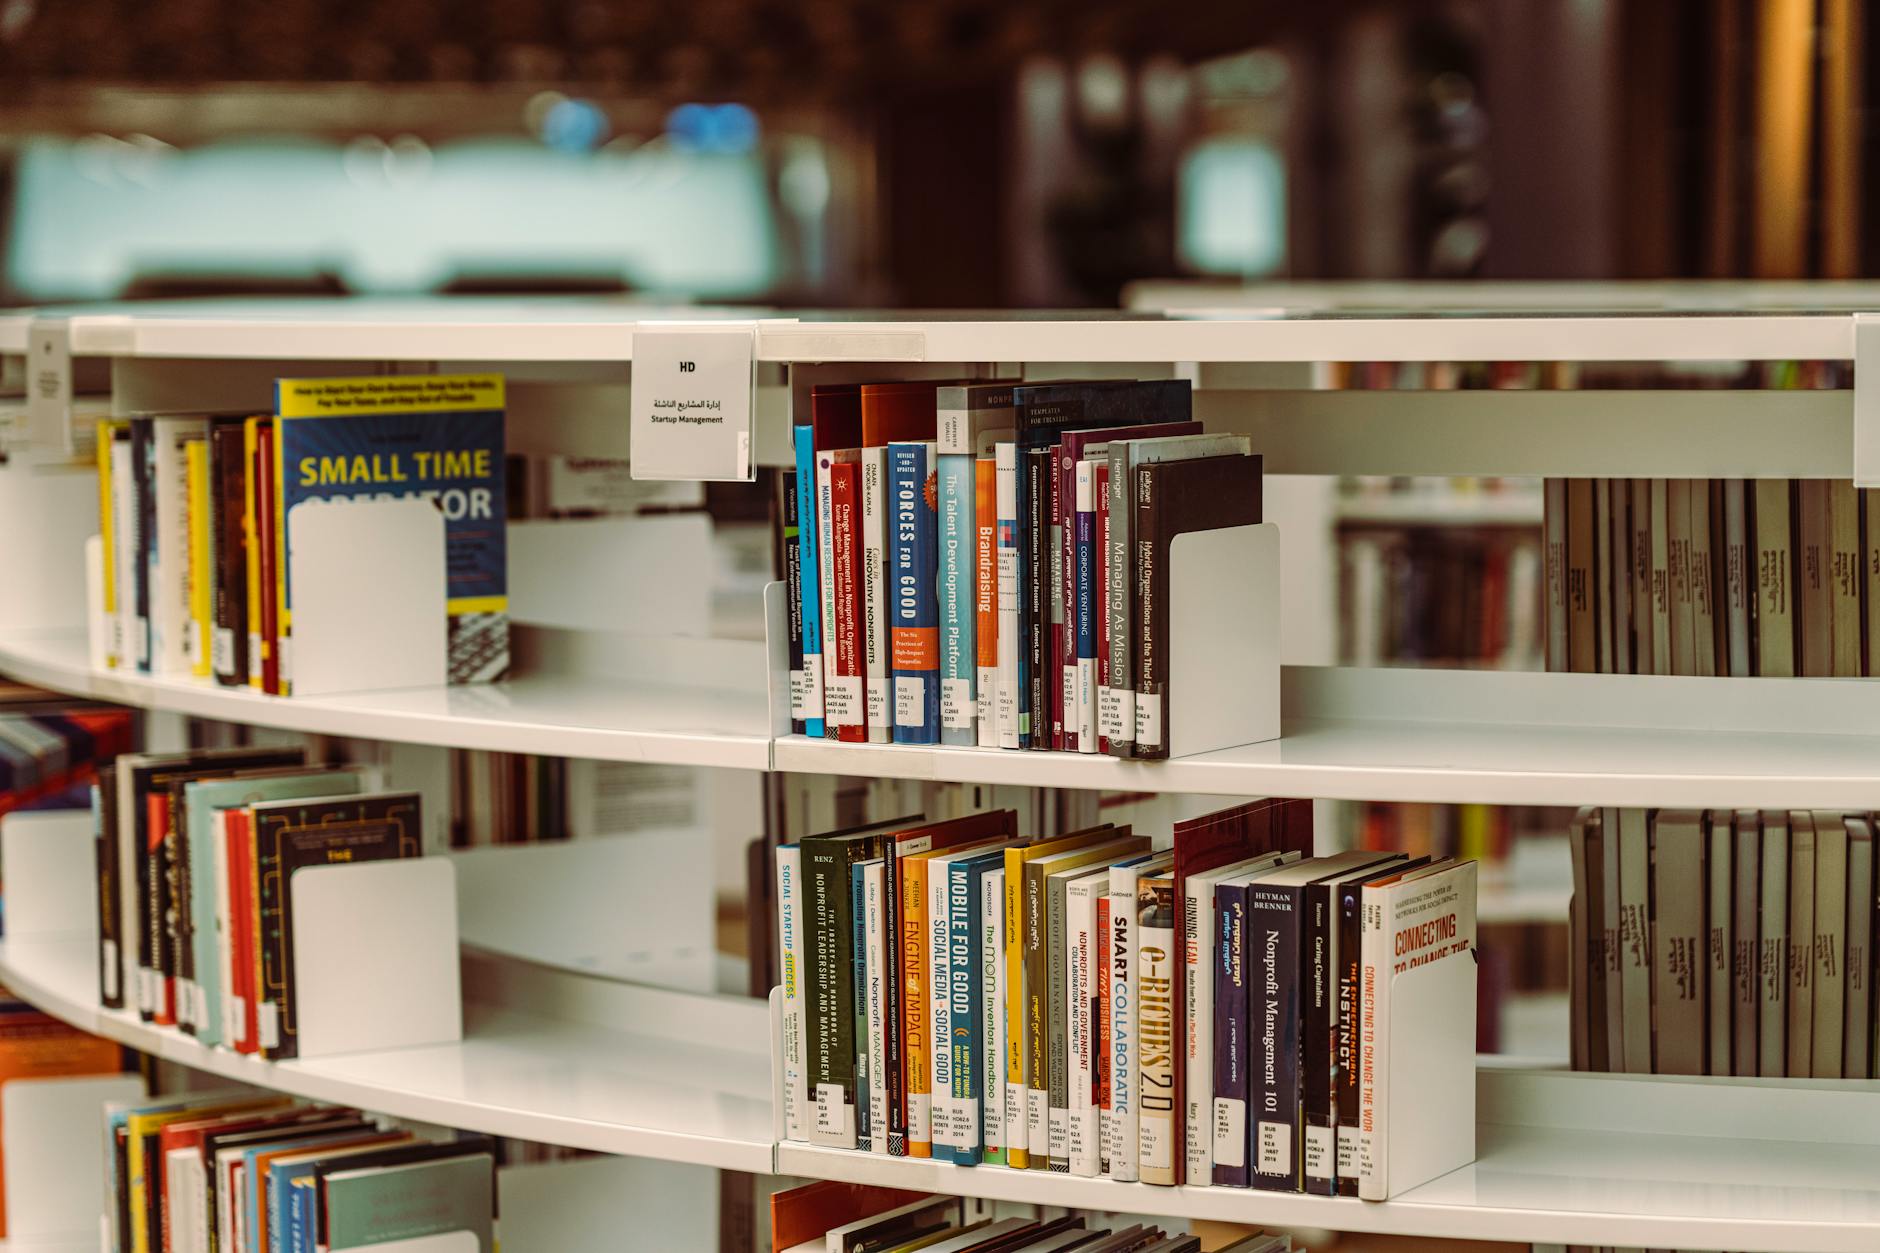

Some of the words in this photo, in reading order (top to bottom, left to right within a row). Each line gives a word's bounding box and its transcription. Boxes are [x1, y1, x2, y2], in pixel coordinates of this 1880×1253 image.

[679, 361, 695, 373] HD
[651, 415, 677, 424] Startup
[678, 416, 723, 425] Management
[654, 399, 676, 408] الناشئة
[677, 400, 705, 412] المشاريع
[706, 400, 721, 411] إدارة
[298, 453, 408, 487] SMALL
[412, 449, 491, 481] TIME
[946, 474, 957, 495] The
[1113, 458, 1122, 500] Heninger
[1144, 470, 1153, 503] palgrave
[821, 485, 830, 520] MANAGING
[841, 504, 850, 532] Change
[899, 480, 915, 542] FORCES
[946, 498, 957, 536] Talent
[823, 521, 832, 546] HUMAN
[824, 547, 834, 586] RESOURCES
[836, 556, 845, 572] Sean
[842, 533, 852, 583] Management
[872, 547, 880, 570] Cases
[900, 547, 911, 568] FOR
[978, 526, 994, 612] Brandraising
[1080, 546, 1088, 590] CORPORATE
[1143, 541, 1153, 568] Hybrid
[837, 572, 846, 598] Edmund
[866, 548, 874, 604] INNOVATIVE
[873, 570, 881, 580] in
[946, 540, 959, 624] Development
[1054, 550, 1062, 599] MANAGING
[1112, 542, 1125, 610] Managing
[826, 587, 834, 600] FOR
[838, 598, 846, 620] Rogers
[845, 593, 854, 630] Nonprofit
[900, 575, 916, 618] GOOD
[1143, 569, 1153, 624] Organizations
[826, 601, 835, 642] NONPROFITS
[867, 606, 875, 664] NONPROFITS
[1114, 614, 1124, 631] As
[1143, 626, 1152, 642] and
[839, 639, 847, 661] Baluch
[1114, 634, 1125, 685] Mission
[1143, 643, 1152, 656] the
[1143, 658, 1153, 679] Third
[814, 855, 834, 863] RENZ
[782, 865, 791, 900] SOCIAL
[815, 873, 826, 927] NONPROFIT
[856, 880, 864, 921] Promoting
[912, 880, 920, 909] MEEHAN
[951, 871, 968, 930] MOBILE
[1255, 892, 1291, 902] HEYMAN
[1030, 895, 1038, 926] الجمعيات
[1186, 897, 1198, 939] RUNNING
[1233, 902, 1244, 918] في
[1253, 901, 1292, 912] BRENNER
[783, 904, 792, 950] STARTUP
[857, 923, 865, 960] Nonprofit
[934, 919, 946, 961] SOCIAL
[986, 925, 995, 944] The
[1232, 919, 1242, 954] منظمات
[1395, 913, 1456, 957] CONNECTING
[817, 930, 827, 990] LEADERSHIP
[905, 921, 920, 981] ENGINE
[952, 935, 969, 966] FOR
[1079, 931, 1088, 988] NONPROFITS
[1186, 940, 1198, 964] LEAN
[1222, 939, 1232, 975] التنظيمي
[1262, 929, 1279, 995] Nonprofit
[1313, 936, 1323, 964] Caring
[785, 953, 794, 999] SUCCESS
[907, 979, 918, 991] of
[934, 963, 948, 1001] MEDIA
[984, 946, 996, 993] mom
[1099, 967, 1109, 997] TINY
[1232, 956, 1242, 987] الأعمال
[1313, 964, 1323, 1008] Capitalism
[819, 993, 827, 1012] AND
[857, 962, 866, 1016] Organizations
[953, 971, 969, 1014] GOOD
[1052, 954, 1060, 1026] GOVERNANCE
[1080, 990, 1088, 1009] AND
[1140, 946, 1171, 1068] e-RICHES
[1363, 966, 1375, 1028] CONNECTING
[906, 991, 922, 1051] IMPACT
[935, 1009, 949, 1052] SOCIAL
[987, 997, 995, 1046] Inventors
[1100, 998, 1110, 1040] BUSINESS
[1340, 978, 1350, 1070] INSTINCT
[1349, 986, 1357, 1086] ENTREPRENEURIAL
[1364, 1030, 1375, 1045] TO
[819, 1016, 829, 1082] MANAGEMENT
[831, 1037, 838, 1048] OF
[1079, 1010, 1088, 1071] GOVERNMENT
[1263, 1000, 1279, 1085] Management
[935, 1053, 949, 1084] GOOD
[1101, 1056, 1110, 1083] SHARON
[1363, 1045, 1374, 1085] CHANGE
[1140, 1071, 1173, 1112] 2.0
[1264, 1091, 1278, 1112] 101
[1363, 1087, 1373, 1105] THE
